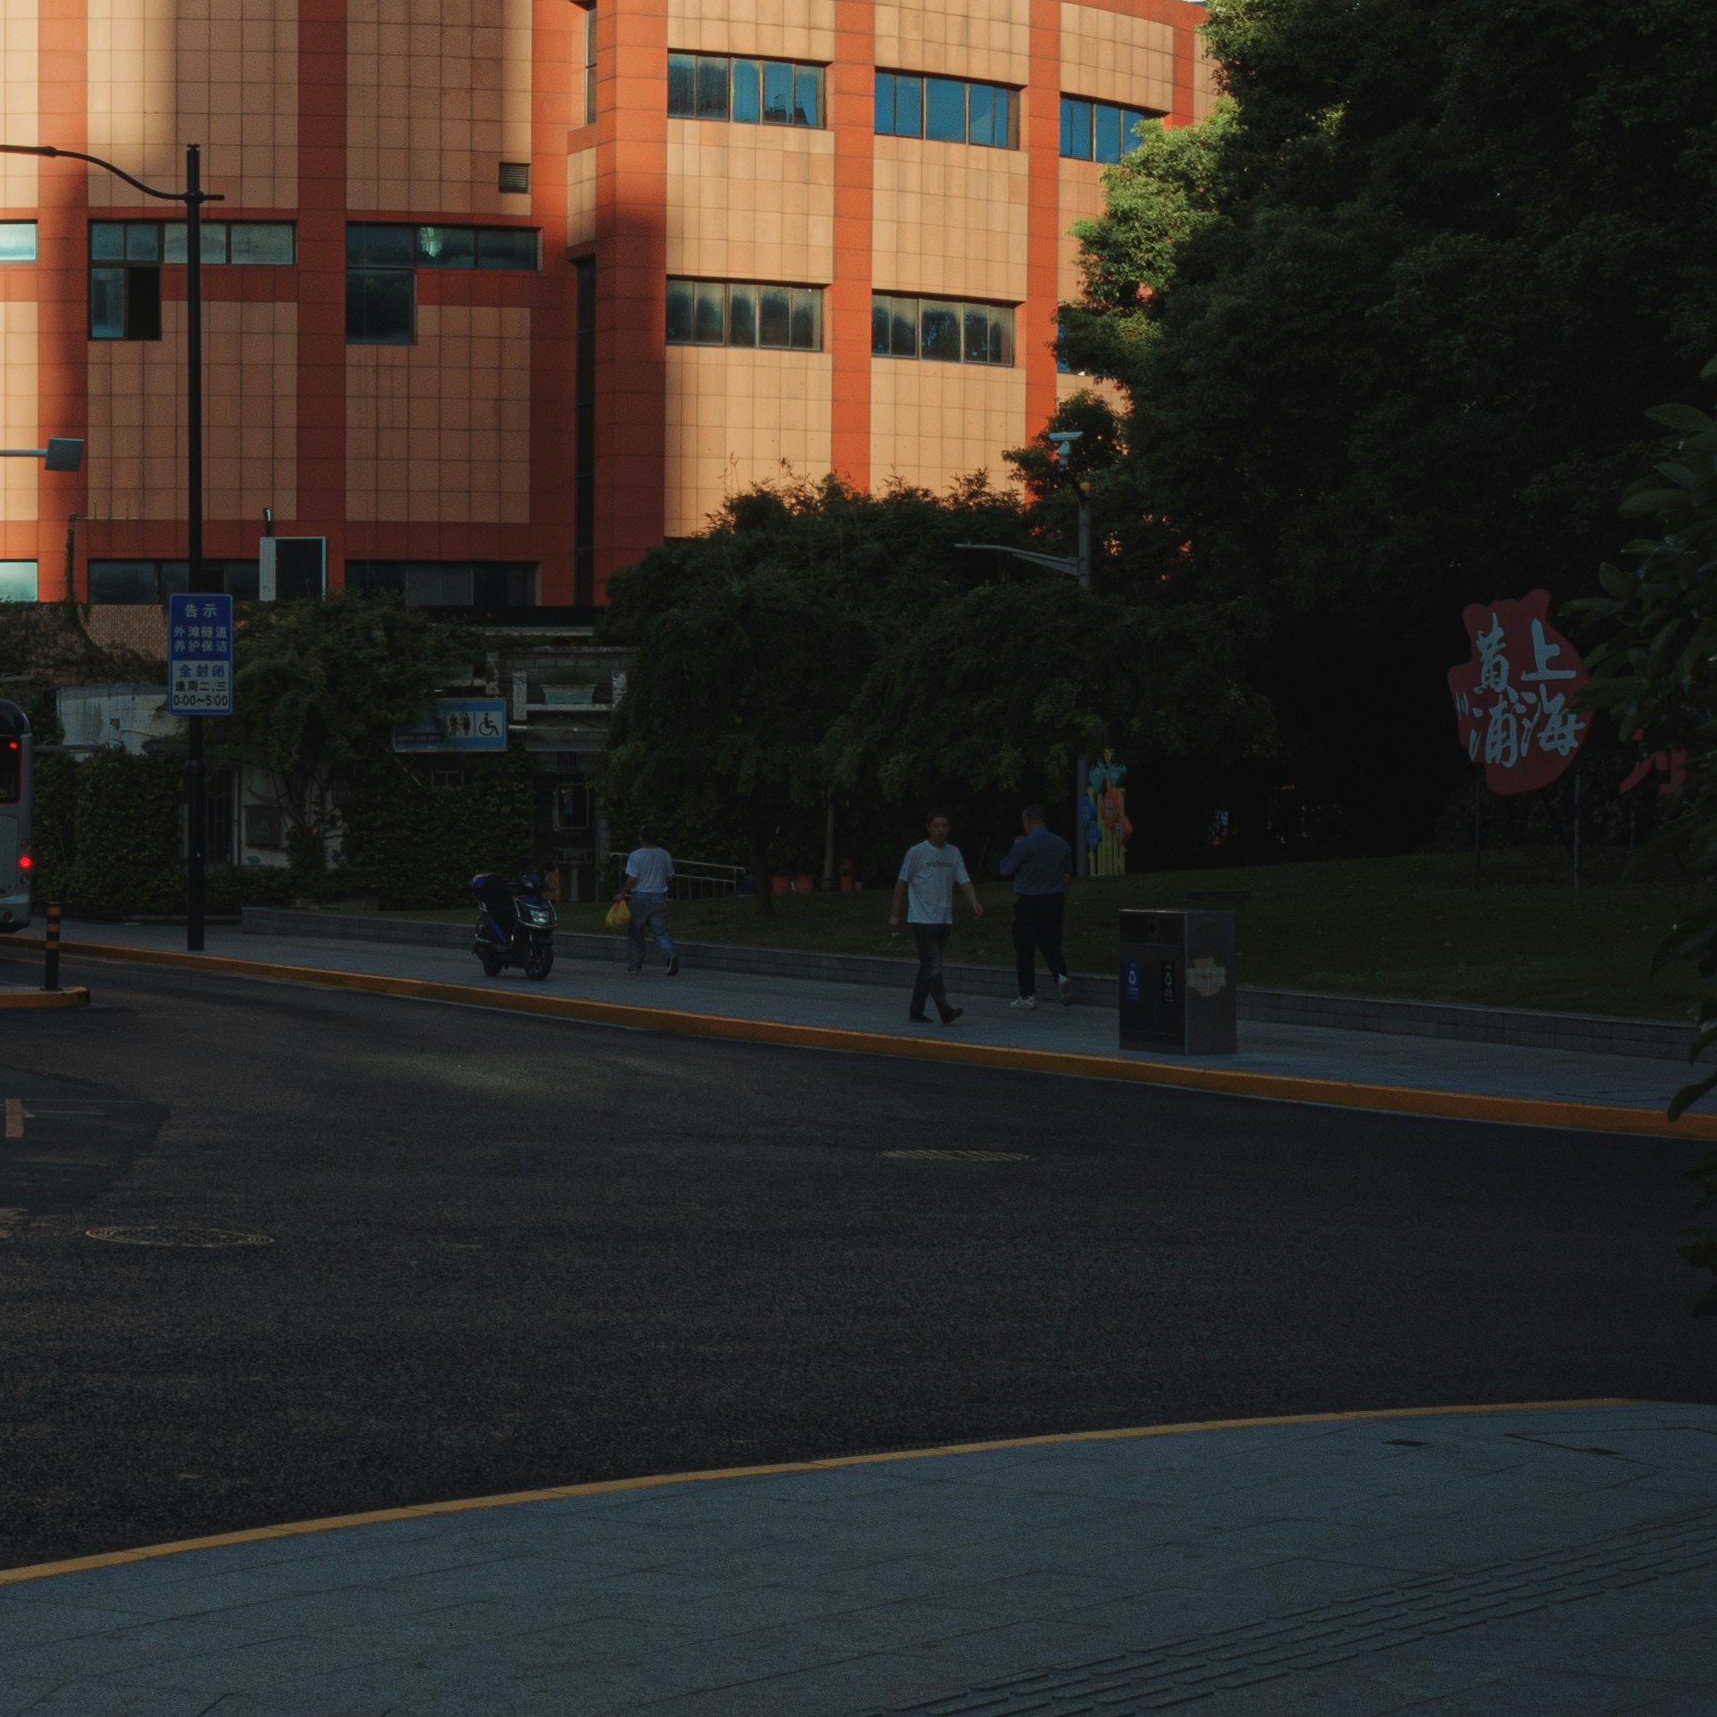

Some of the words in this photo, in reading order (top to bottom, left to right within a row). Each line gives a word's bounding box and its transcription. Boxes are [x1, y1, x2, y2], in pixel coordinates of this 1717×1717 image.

[184, 603, 218, 619] 告示
[173, 640, 228, 653] 养护保洁
[179, 664, 225, 678] 全封闭
[1468, 611, 1526, 768] 黄浦
[1520, 618, 1586, 757] 上海
